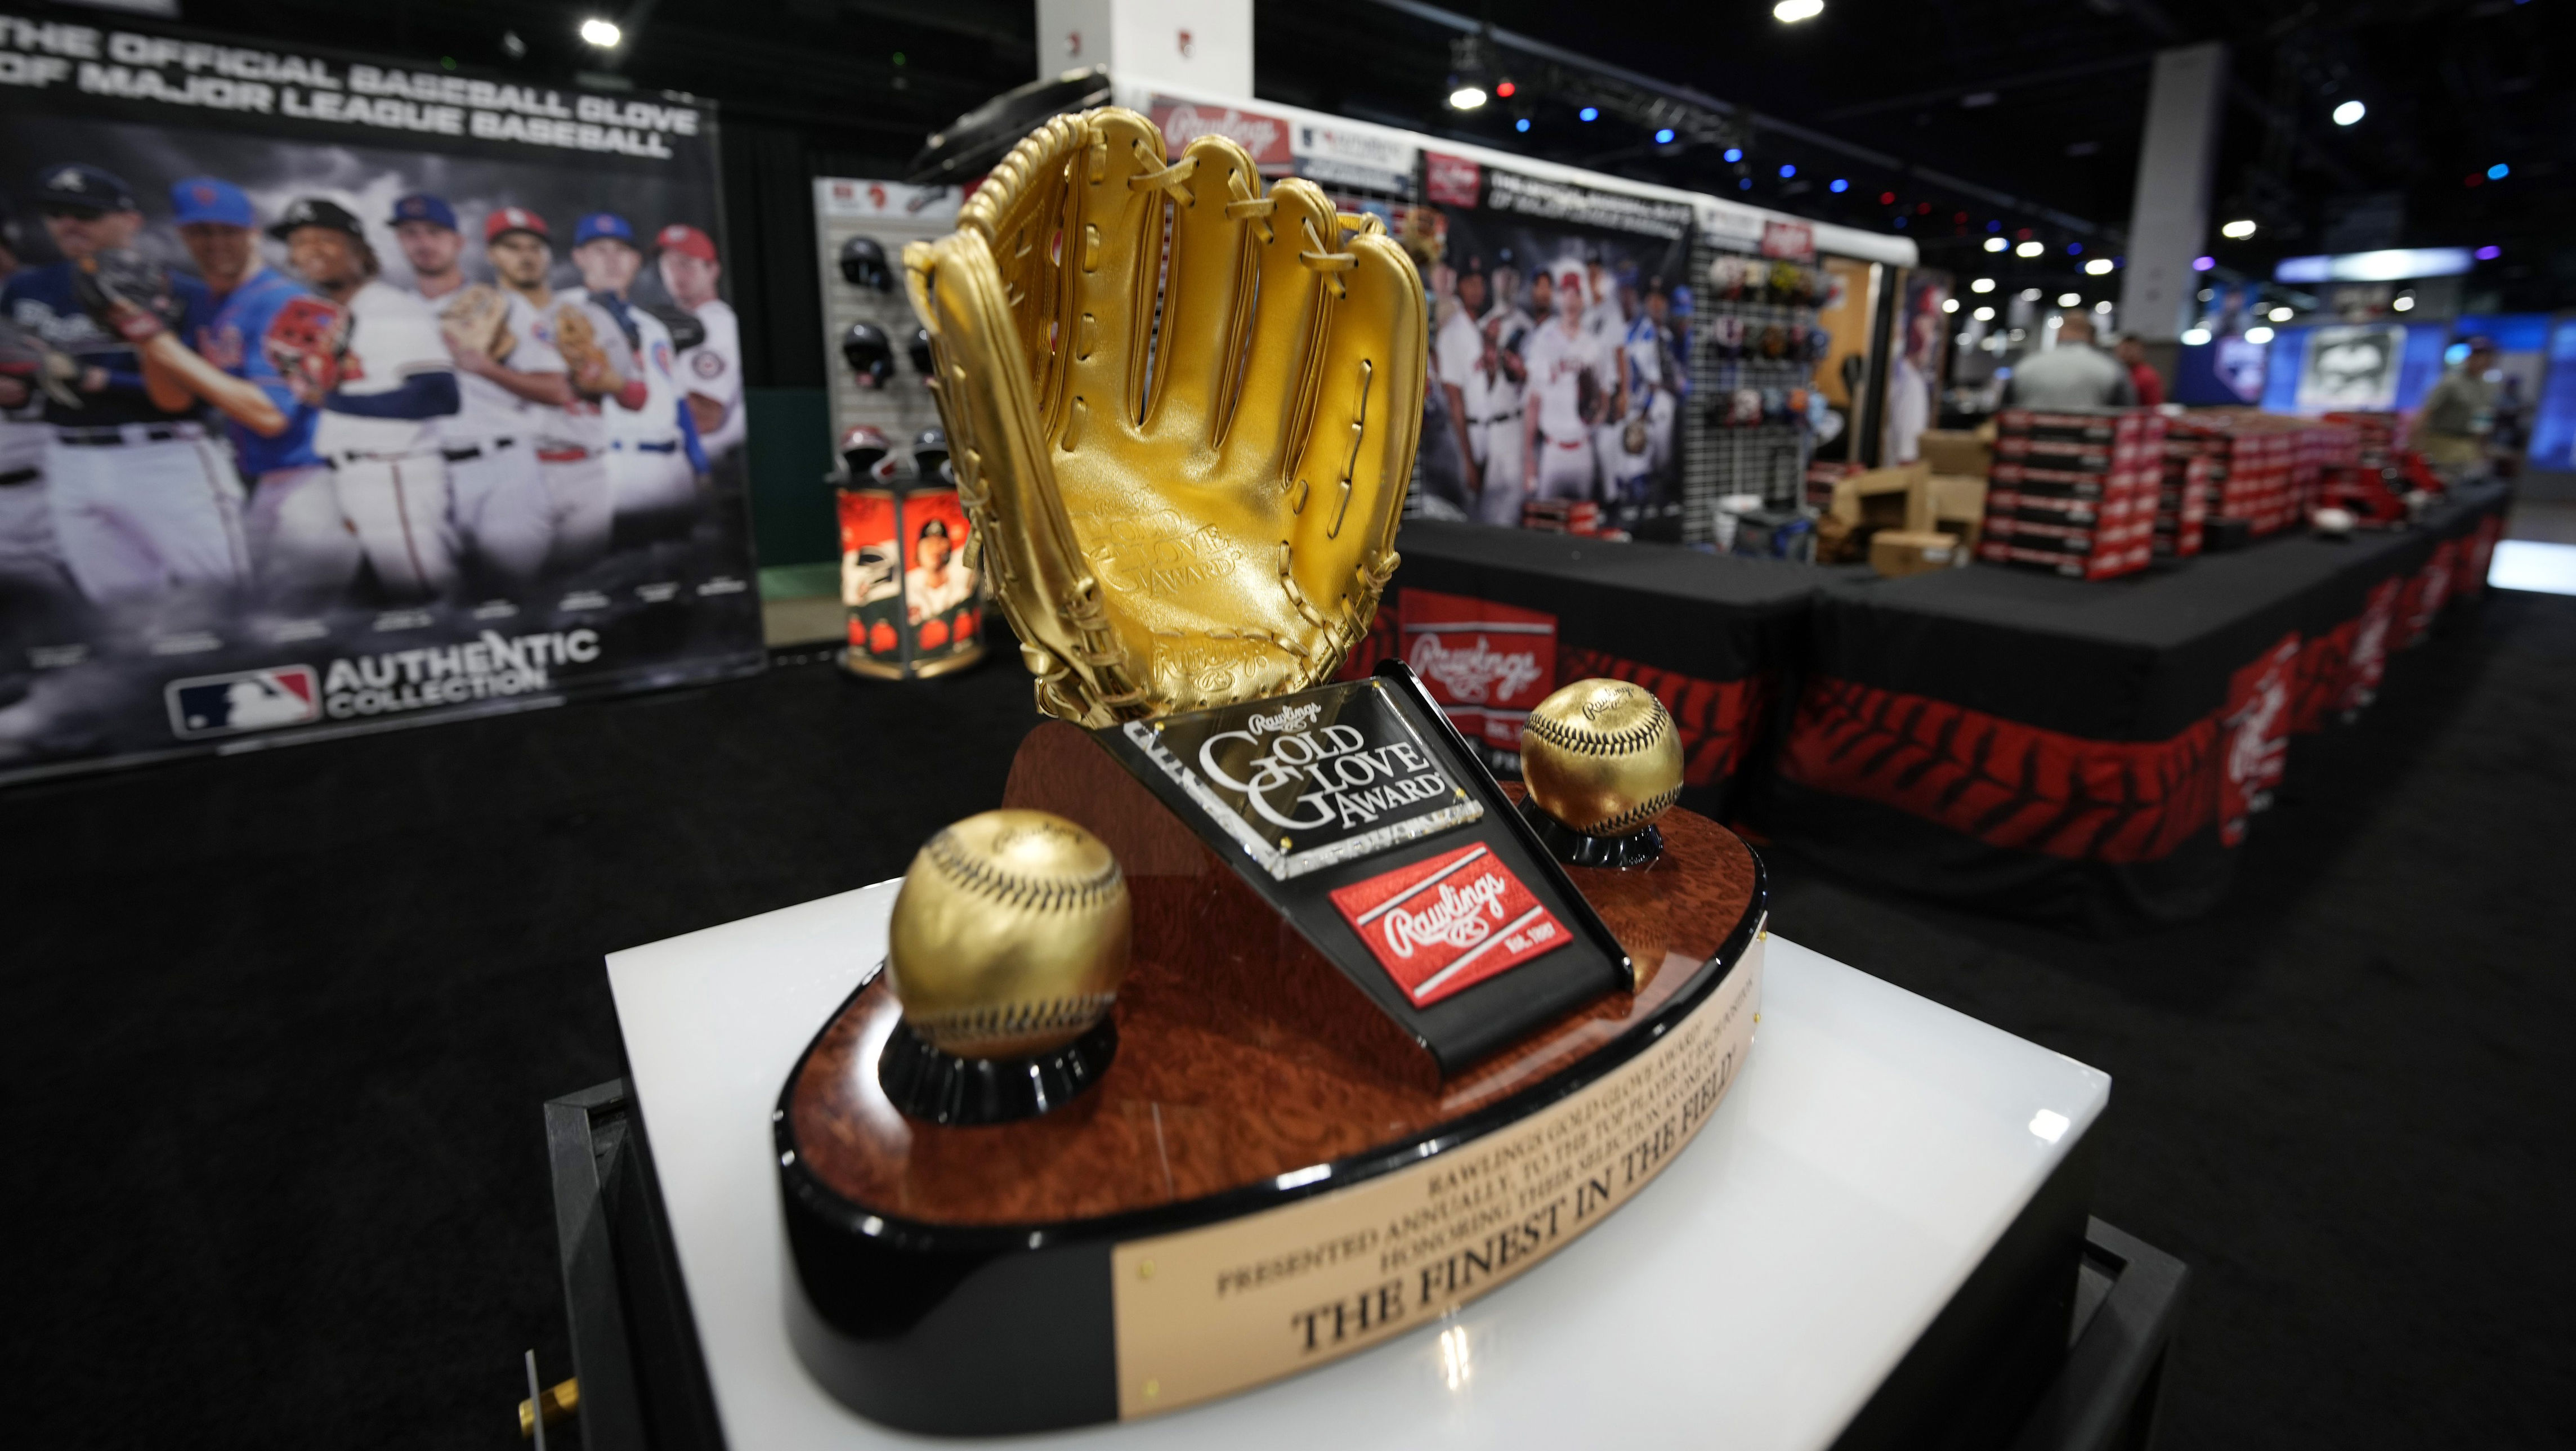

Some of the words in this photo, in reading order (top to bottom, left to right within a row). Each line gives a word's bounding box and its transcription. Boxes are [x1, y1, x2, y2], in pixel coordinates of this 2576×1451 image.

[77, 61, 275, 114] MAJOR
[281, 87, 466, 137] LEAGUE
[469, 110, 674, 160] BASEBALL
[108, 32, 343, 89] OFFICIAL
[348, 63, 572, 119] BASEBALL
[576, 95, 699, 136] GLOVE
[325, 668, 549, 720] COLLECTION
[326, 628, 601, 693] AUTHENTIC
[1248, 702, 1322, 735] Rawlings
[1198, 724, 1365, 792] GOLD
[1247, 741, 1430, 830] GLOVE
[1383, 872, 1506, 959] Rawlings
[1428, 1129, 1544, 1197] RAWLINGS
[1217, 1226, 1379, 1299] PRESENTED
[1291, 1277, 1404, 1352] THE
[1419, 1195, 1566, 1305] FINEST
[1575, 1163, 1612, 1220] IN
[1621, 1114, 1676, 1186] THE
[1380, 1197, 1513, 1275] HONORING
